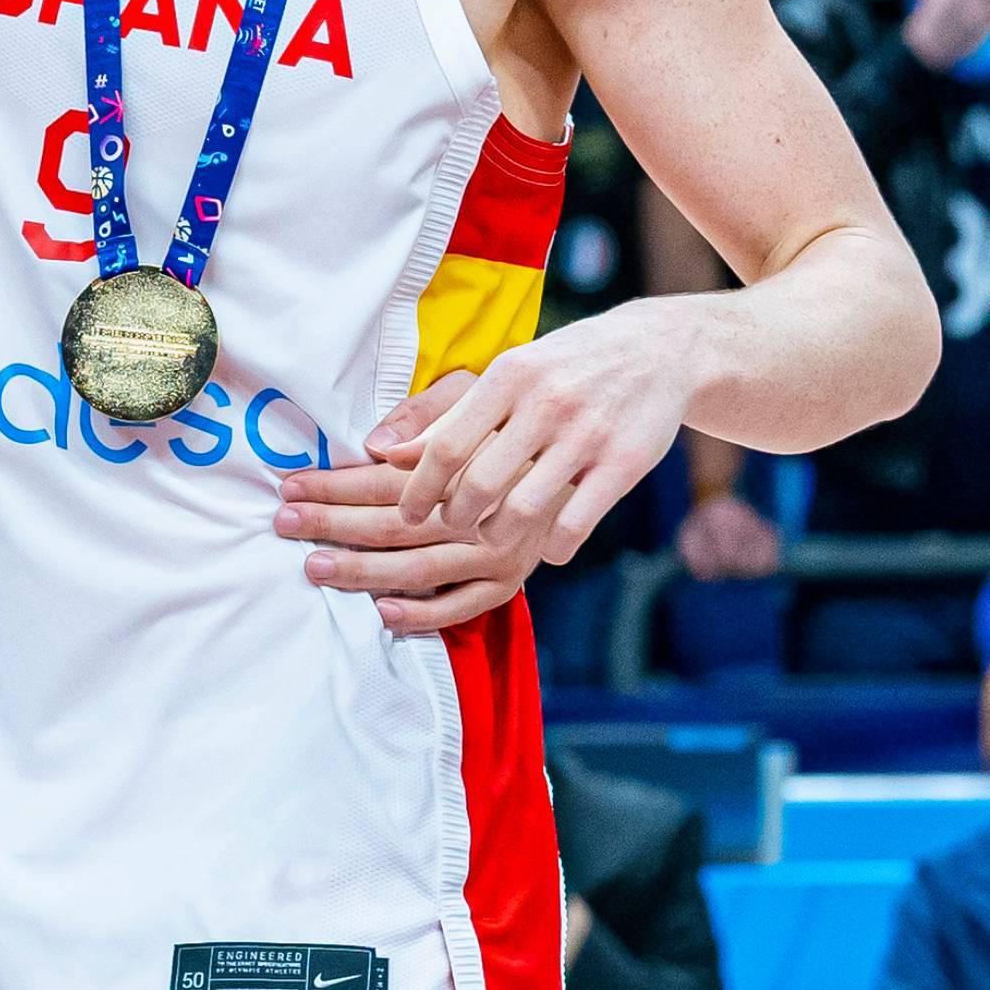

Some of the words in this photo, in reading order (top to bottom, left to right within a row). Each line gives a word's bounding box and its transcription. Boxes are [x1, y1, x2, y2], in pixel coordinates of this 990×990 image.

[21, 108, 131, 262] 9
[217, 951, 302, 962] ENGINEERED
[182, 972, 204, 989] 50
